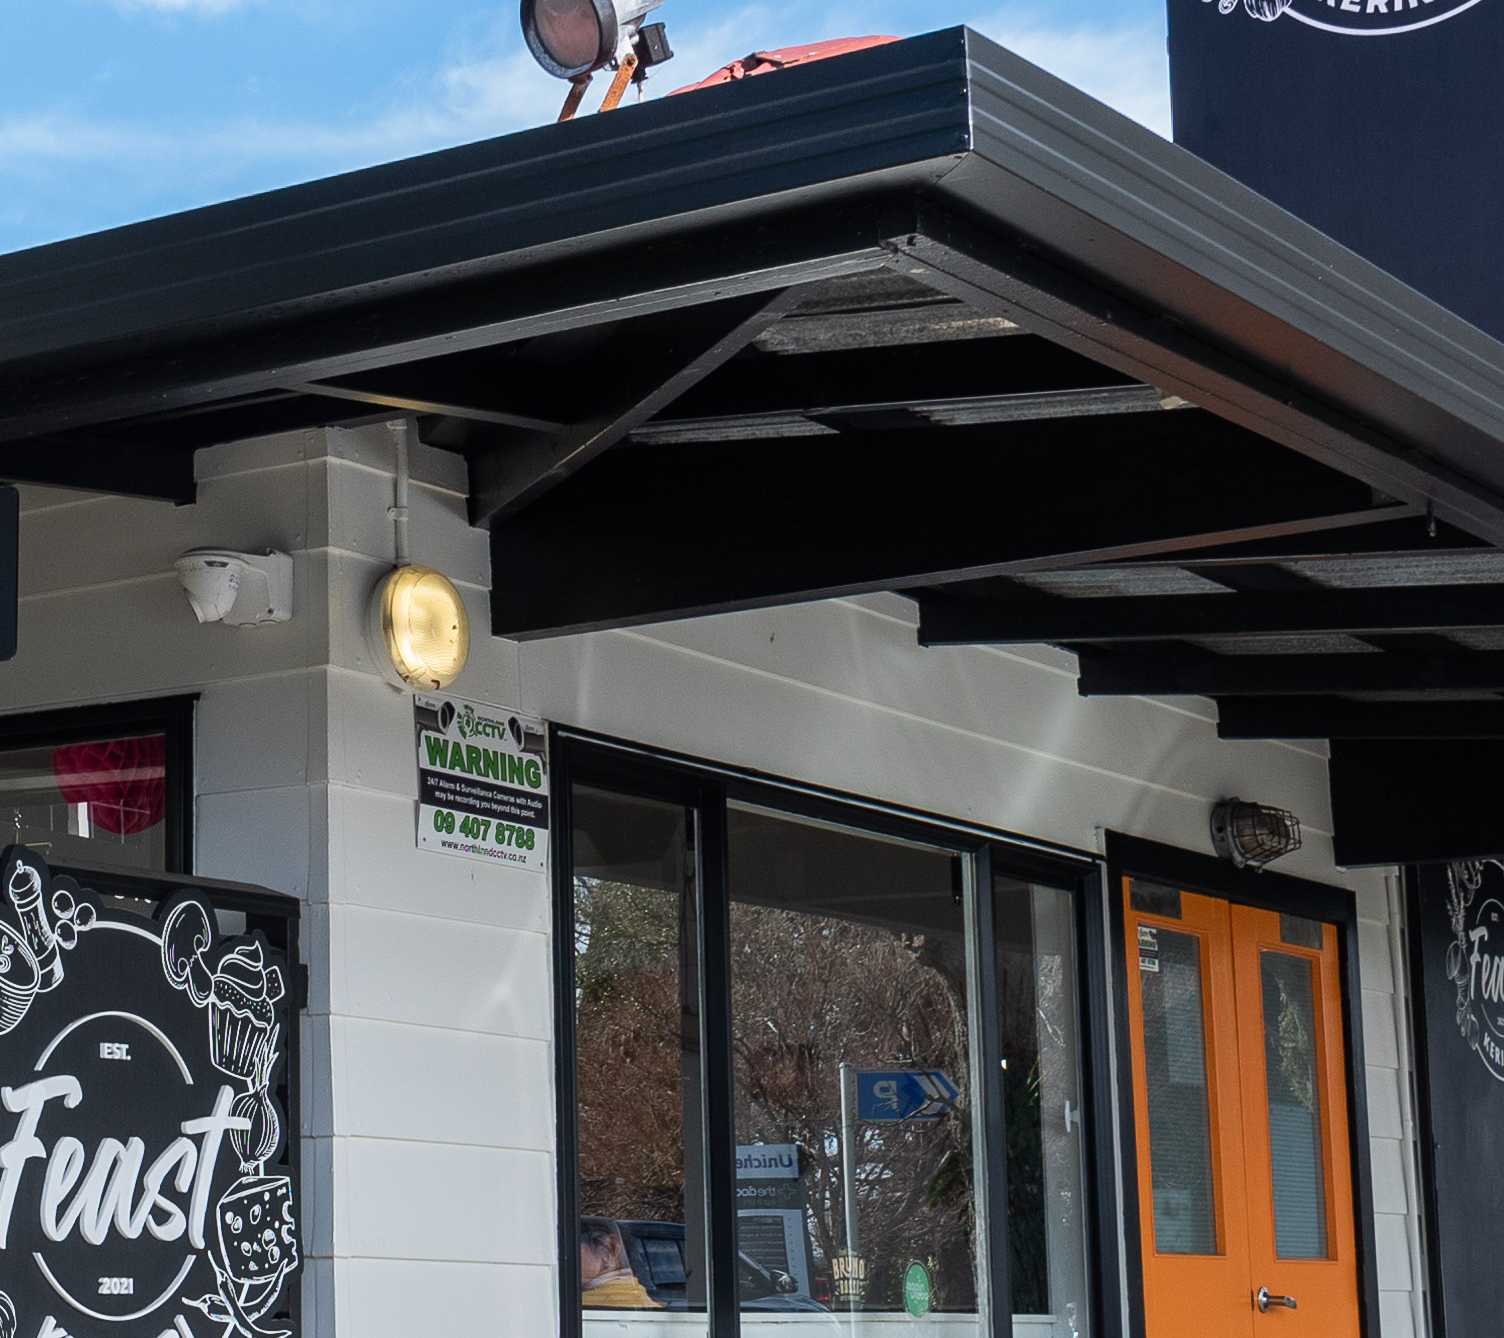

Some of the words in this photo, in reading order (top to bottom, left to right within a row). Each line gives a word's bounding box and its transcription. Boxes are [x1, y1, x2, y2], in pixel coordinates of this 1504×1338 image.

[474, 721, 506, 740] CCTV
[424, 734, 542, 789] WARNING
[435, 791, 446, 801] may
[447, 792, 454, 801] be
[455, 795, 479, 808] recording
[480, 801, 490, 809] you
[491, 802, 510, 813] beyond
[511, 805, 520, 815] this
[461, 784, 492, 798] Surveillance
[493, 791, 515, 803] Cameras
[516, 795, 527, 805] with
[527, 799, 542, 809] Audio
[433, 809, 456, 834] 09
[459, 815, 491, 841] 407
[495, 822, 535, 850] 8788
[441, 839, 527, 863] www.northlandcctv.co.nz
[99, 1041, 132, 1061] EST.
[832, 1257, 865, 1280] BRUNO
[98, 1276, 134, 1295] 2021
